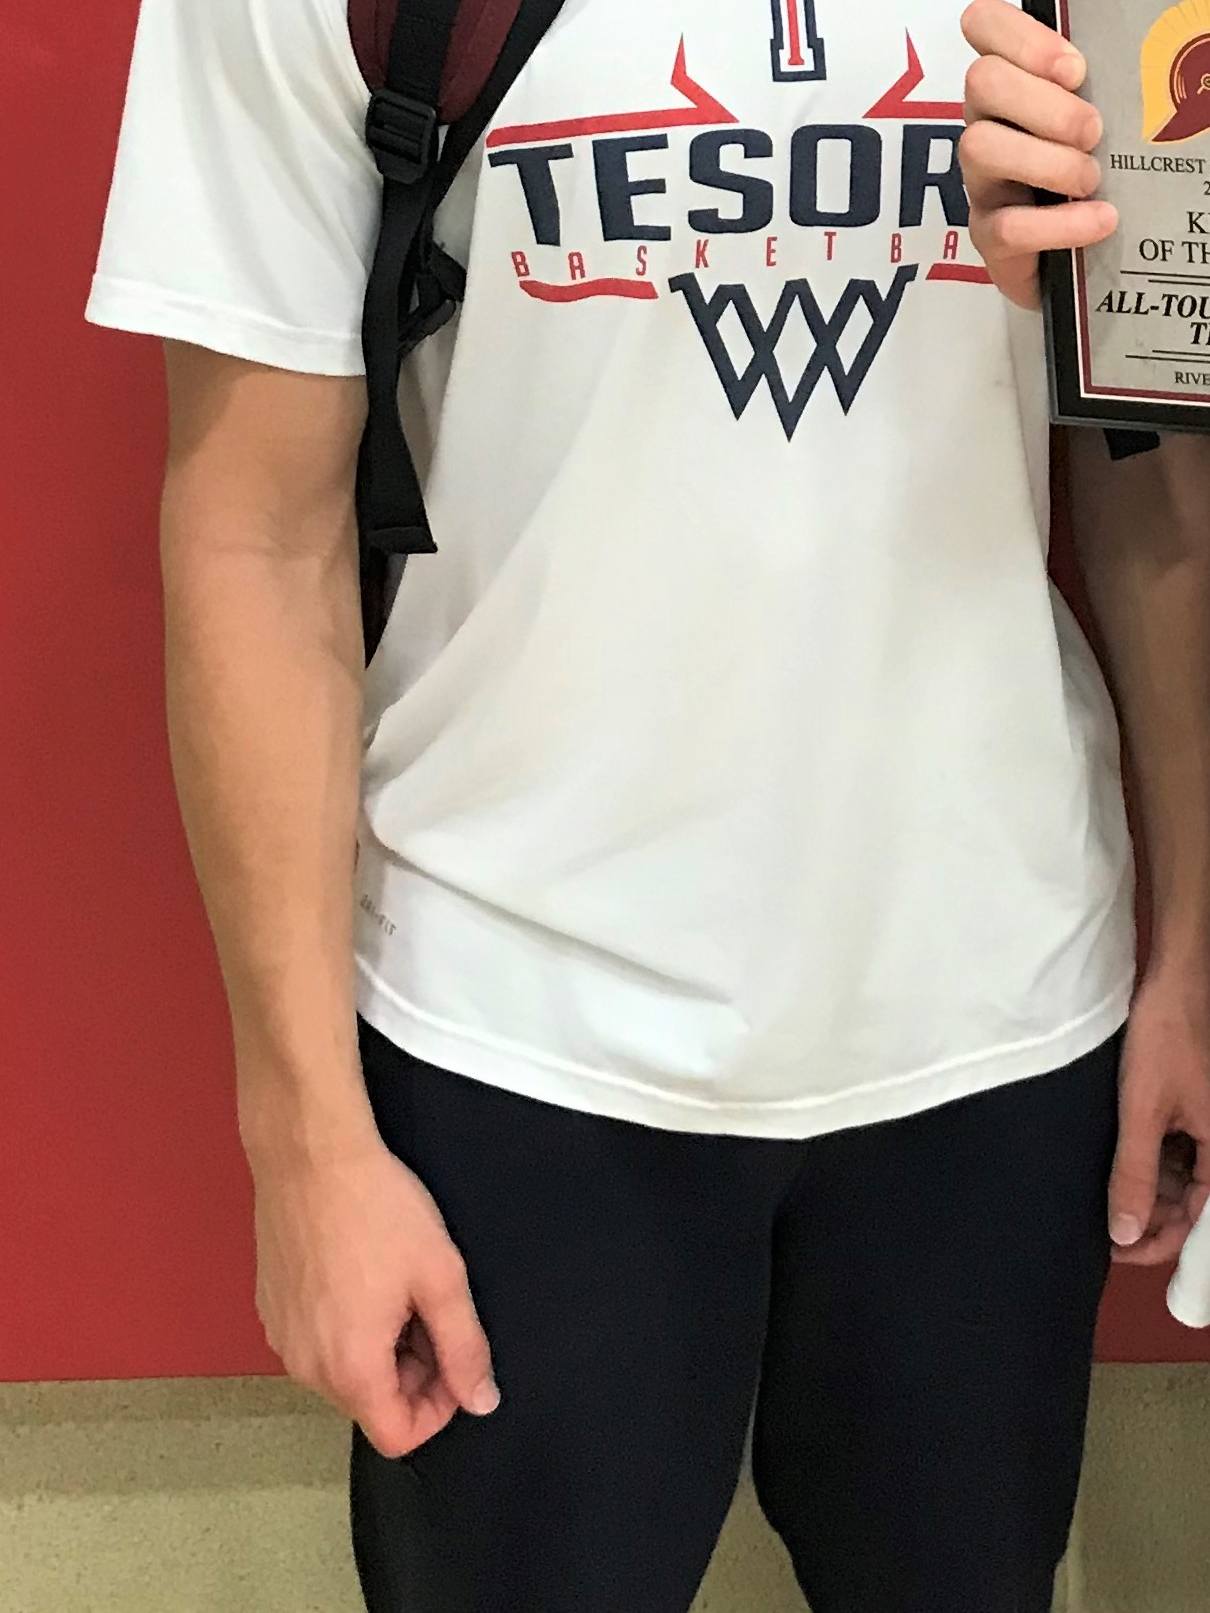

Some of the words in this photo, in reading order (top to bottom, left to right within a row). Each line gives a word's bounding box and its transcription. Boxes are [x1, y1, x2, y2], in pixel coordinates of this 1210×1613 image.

[1109, 153, 1207, 175] HILLCREST
[488, 123, 969, 247] TESOR
[511, 230, 959, 279] BASKETBA
[1138, 237, 1175, 263] OF
